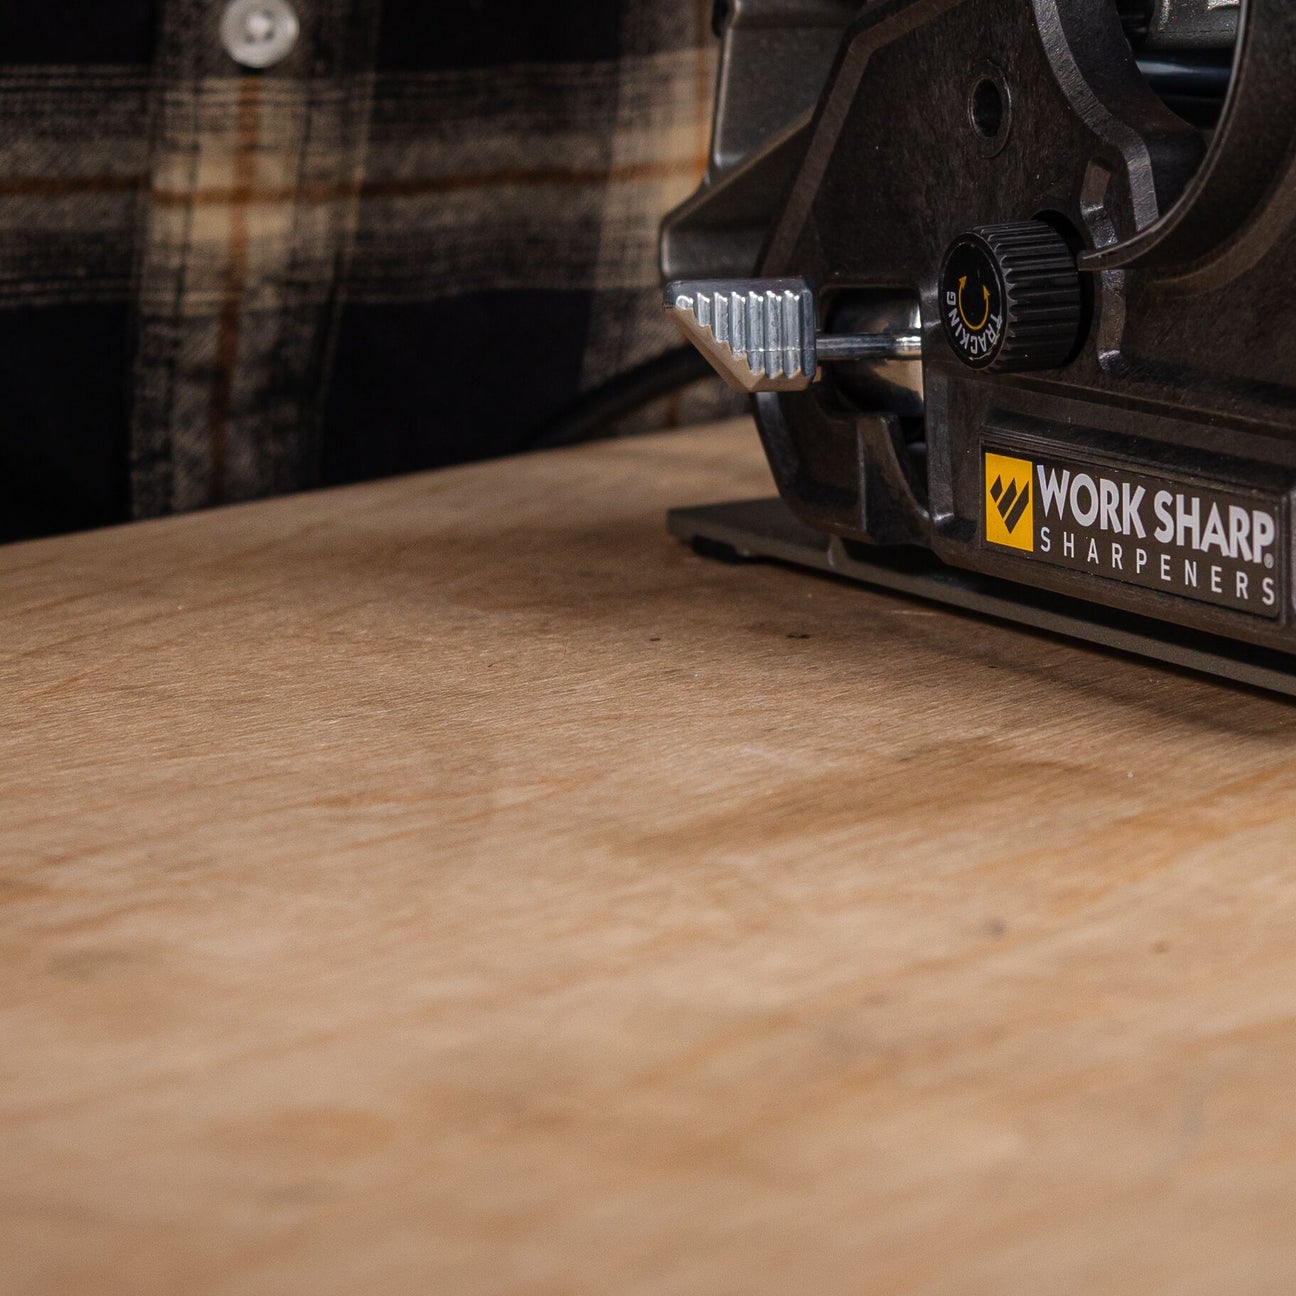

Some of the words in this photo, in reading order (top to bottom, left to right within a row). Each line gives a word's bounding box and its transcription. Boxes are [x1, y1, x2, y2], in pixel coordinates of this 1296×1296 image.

[946, 291, 1002, 354] TRACKING
[1037, 464, 1146, 539] WORK
[1040, 526, 1275, 606] SHARPENERS
